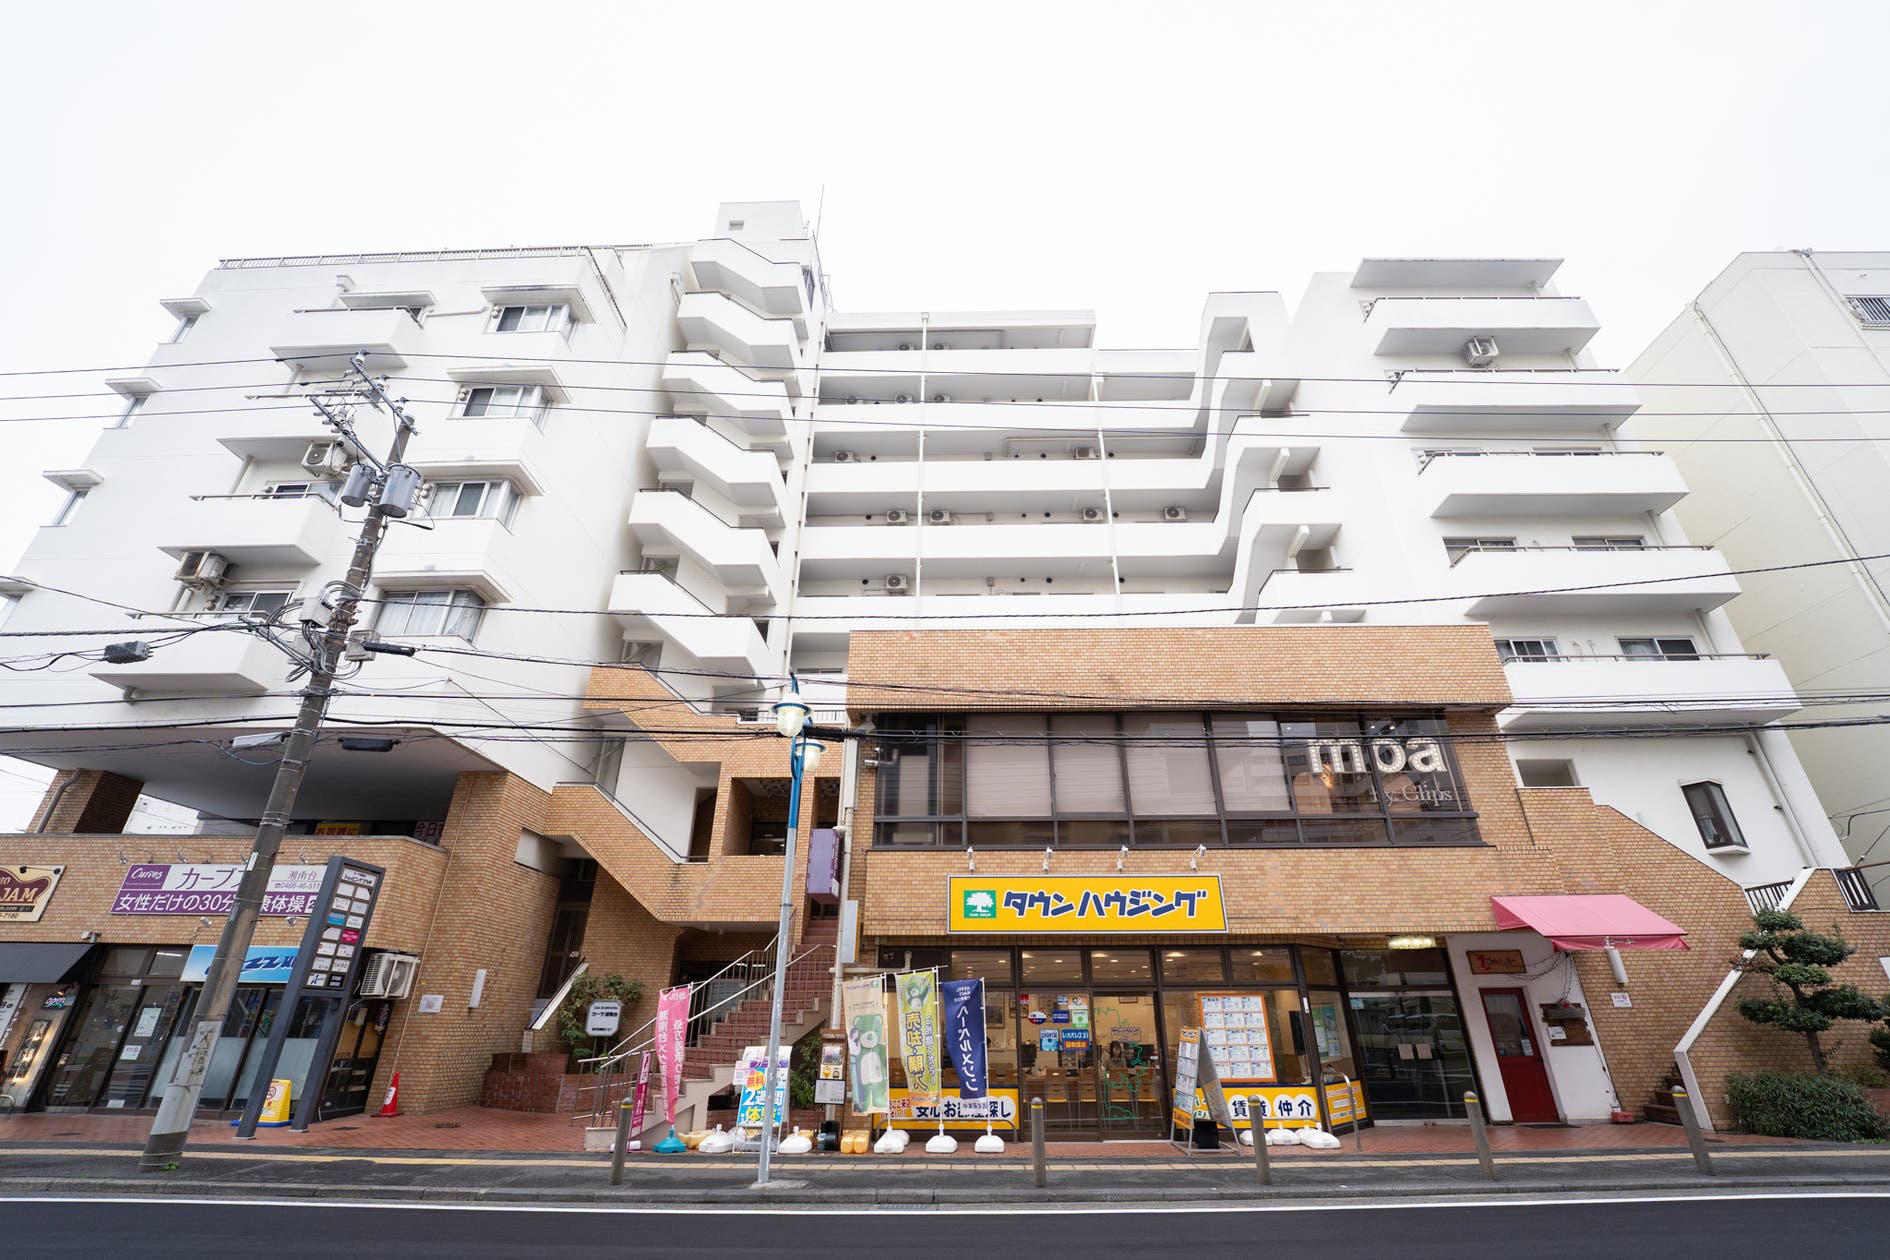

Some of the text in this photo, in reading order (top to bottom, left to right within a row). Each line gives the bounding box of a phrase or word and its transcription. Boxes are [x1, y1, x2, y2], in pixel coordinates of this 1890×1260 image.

[1307, 737, 1448, 774] moa
[1401, 784, 1452, 807] Clips
[288, 870, 318, 881] 湘南台
[0, 887, 38, 902] JAM
[280, 881, 320, 890] 0466-46-511
[1003, 889, 1208, 918] タウンハウジング
